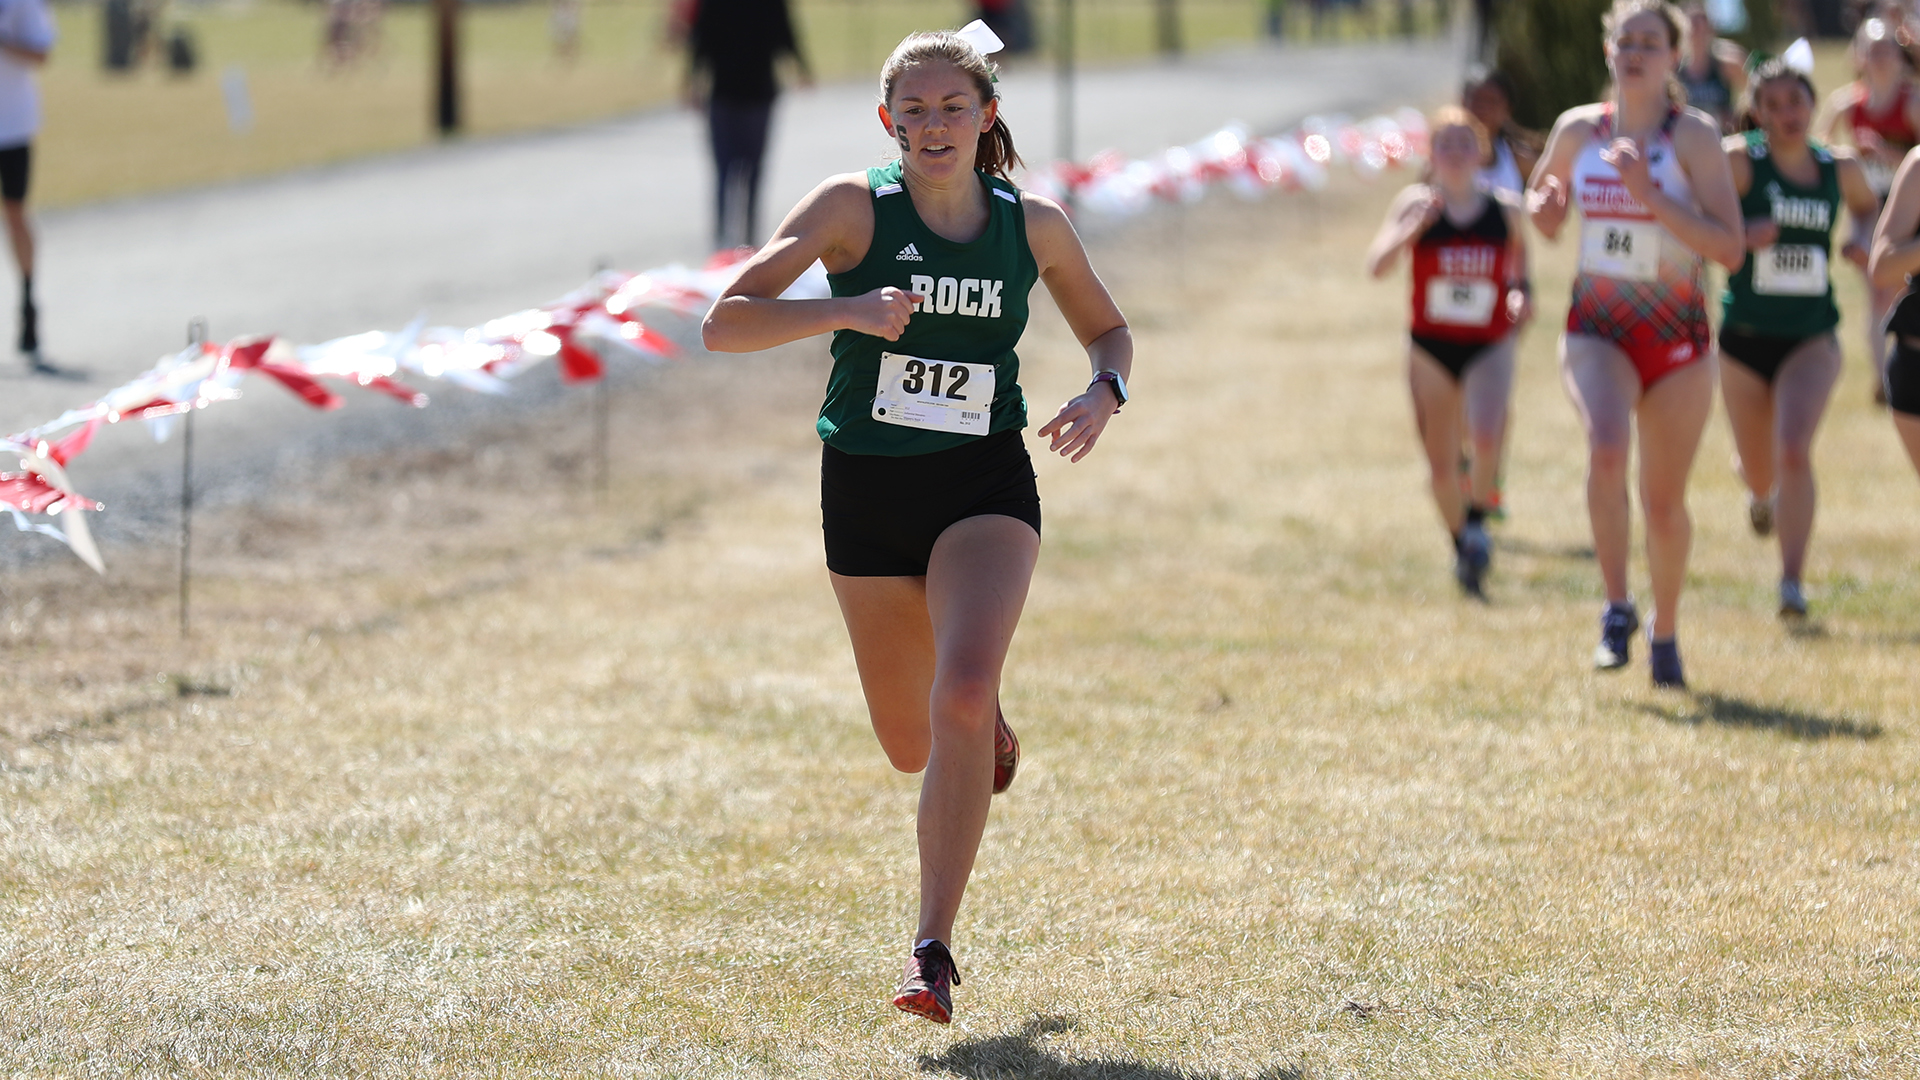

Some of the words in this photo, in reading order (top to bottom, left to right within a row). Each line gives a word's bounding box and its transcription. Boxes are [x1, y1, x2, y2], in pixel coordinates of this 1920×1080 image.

[1770, 196, 1830, 231] ROCK
[895, 253, 924, 262] adidas
[1604, 228, 1633, 255] 84
[910, 274, 1003, 318] ROCK
[902, 359, 970, 401] 312
